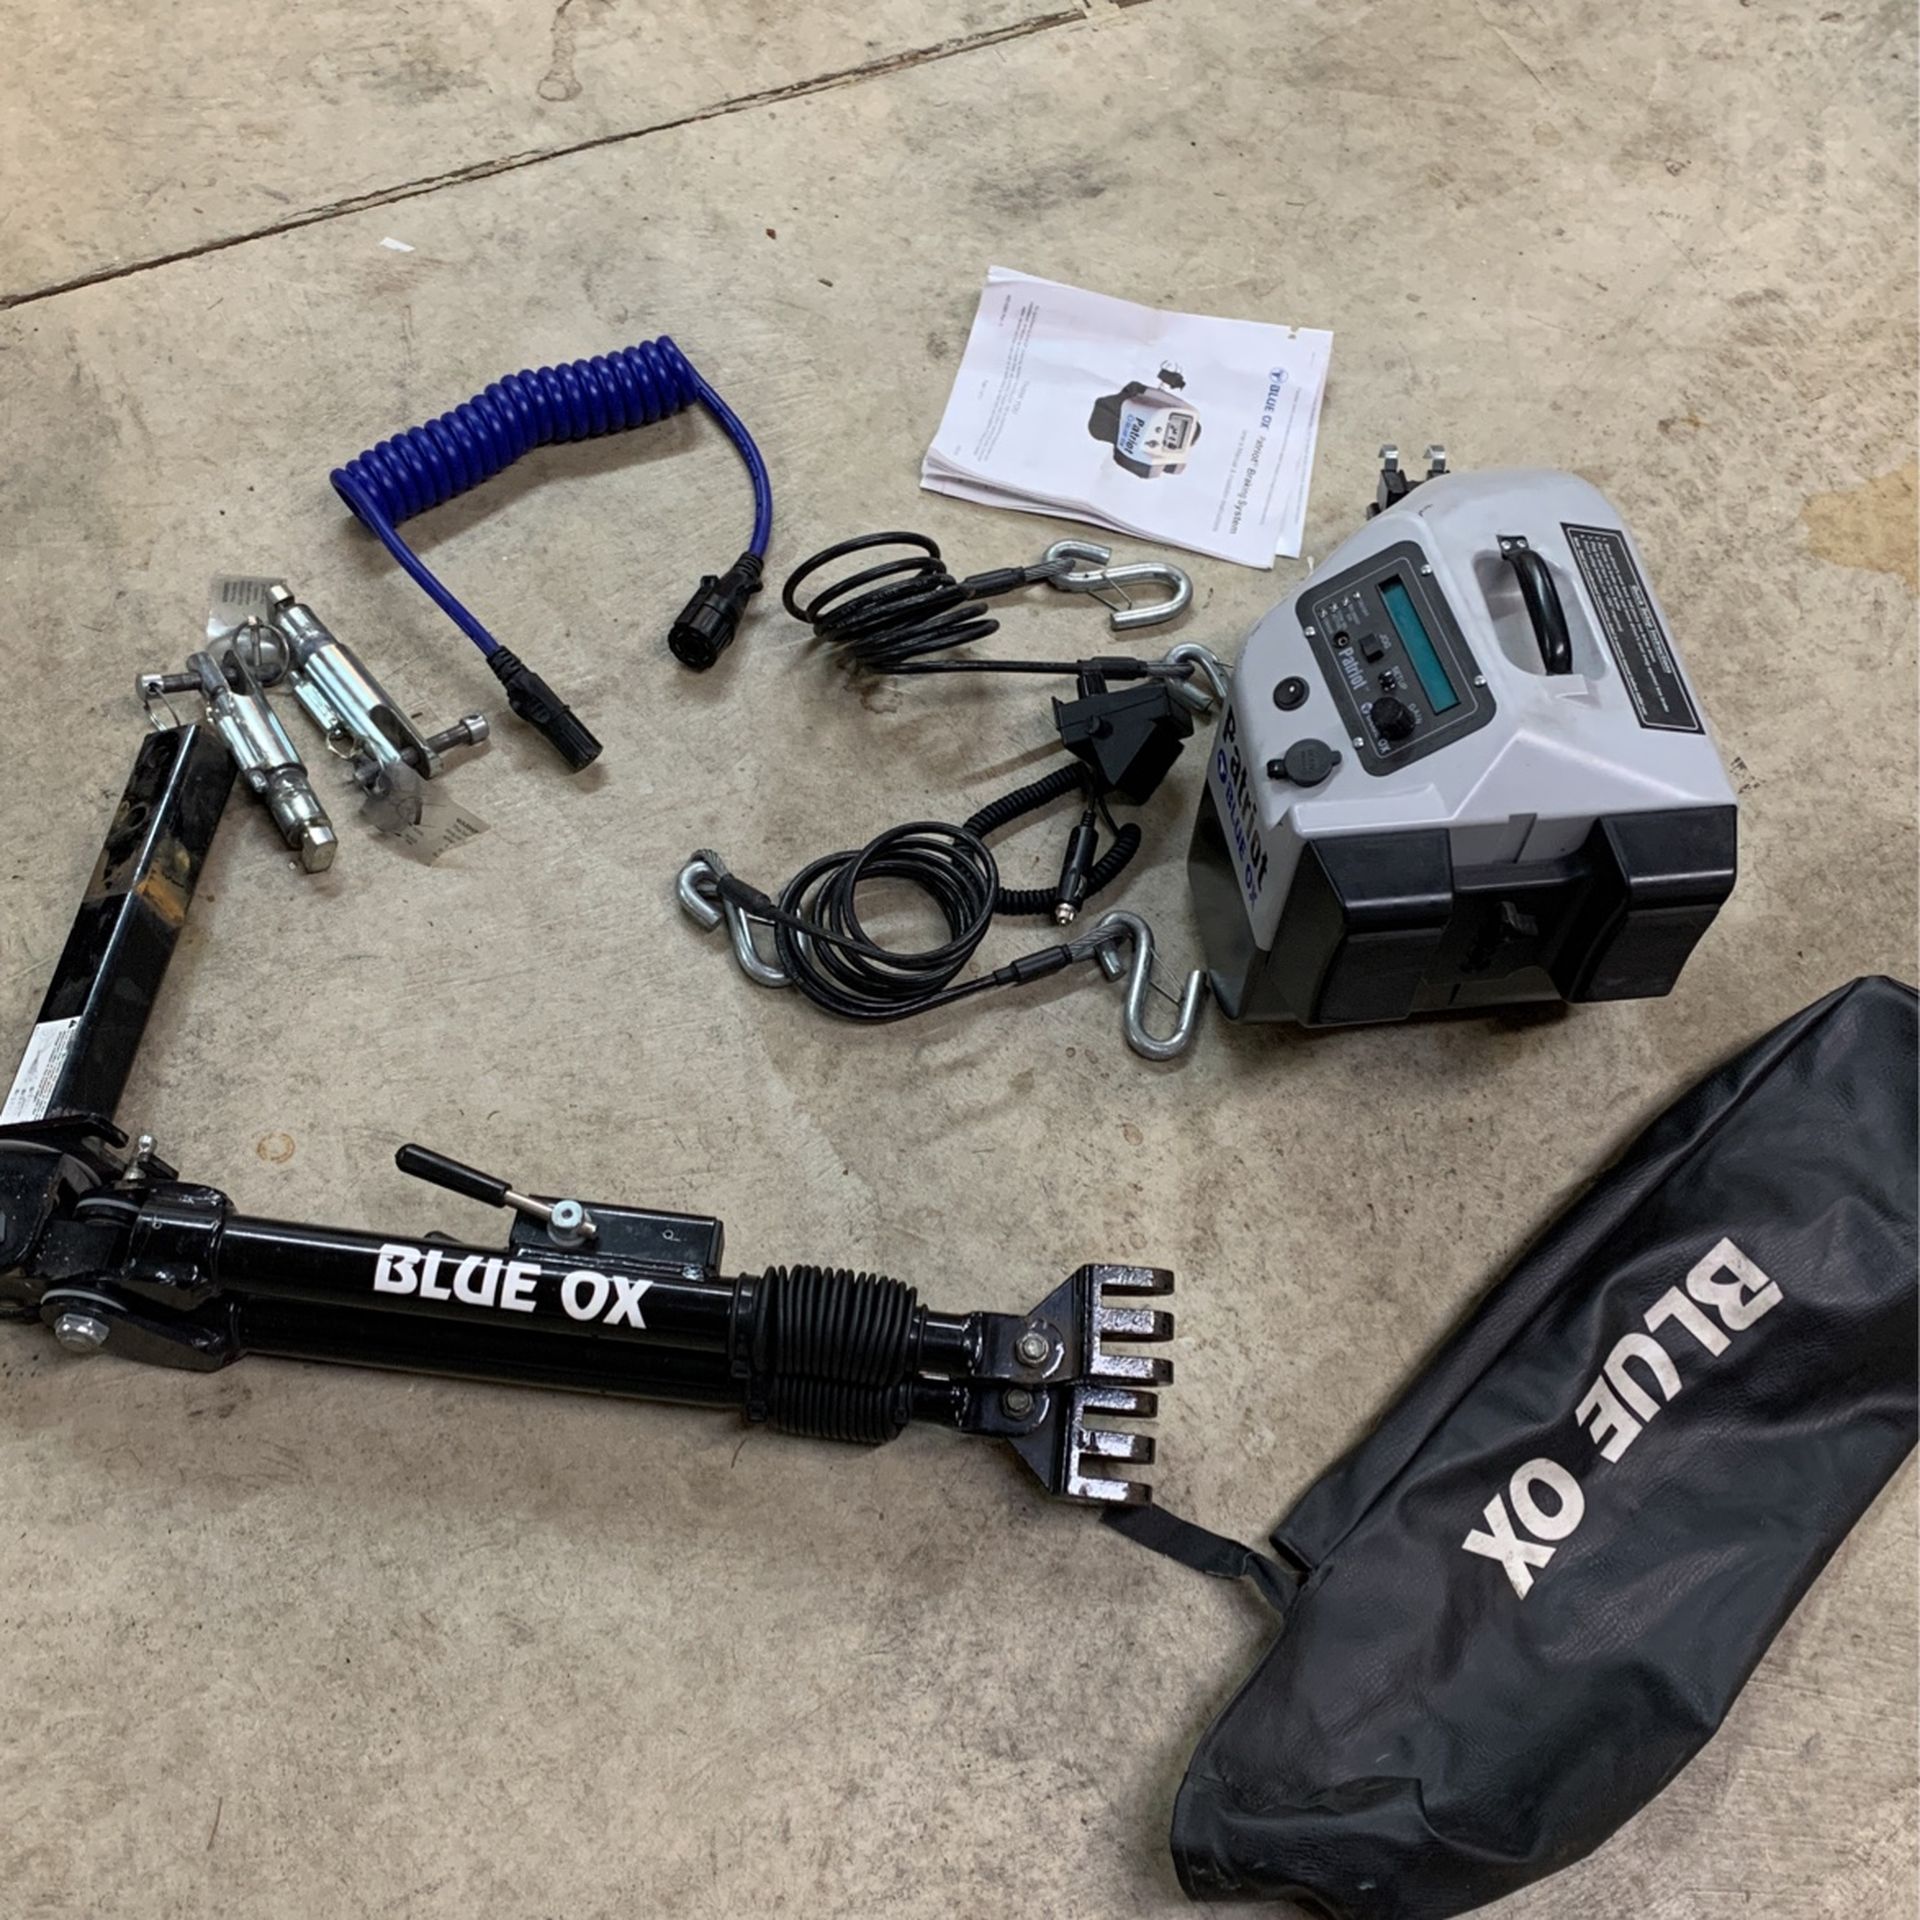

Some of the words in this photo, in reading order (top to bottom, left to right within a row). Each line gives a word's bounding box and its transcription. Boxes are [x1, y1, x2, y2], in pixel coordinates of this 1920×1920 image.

[1265, 384, 1280, 412] BLUE
[1124, 417, 1145, 454] Patriot
[1260, 414, 1272, 429] OX
[1238, 467, 1256, 499] Braking
[1229, 499, 1248, 535] System
[1379, 633, 1392, 649] JOG
[1391, 665, 1408, 690] SETUP
[1223, 704, 1268, 891] Patriot
[1225, 783, 1247, 859] BLUE
[1244, 863, 1258, 911] OX
[373, 1244, 541, 1311] BLUE
[560, 1272, 653, 1329] OX
[1575, 1237, 1783, 1463] BLUE
[1462, 1458, 1585, 1600] OX
